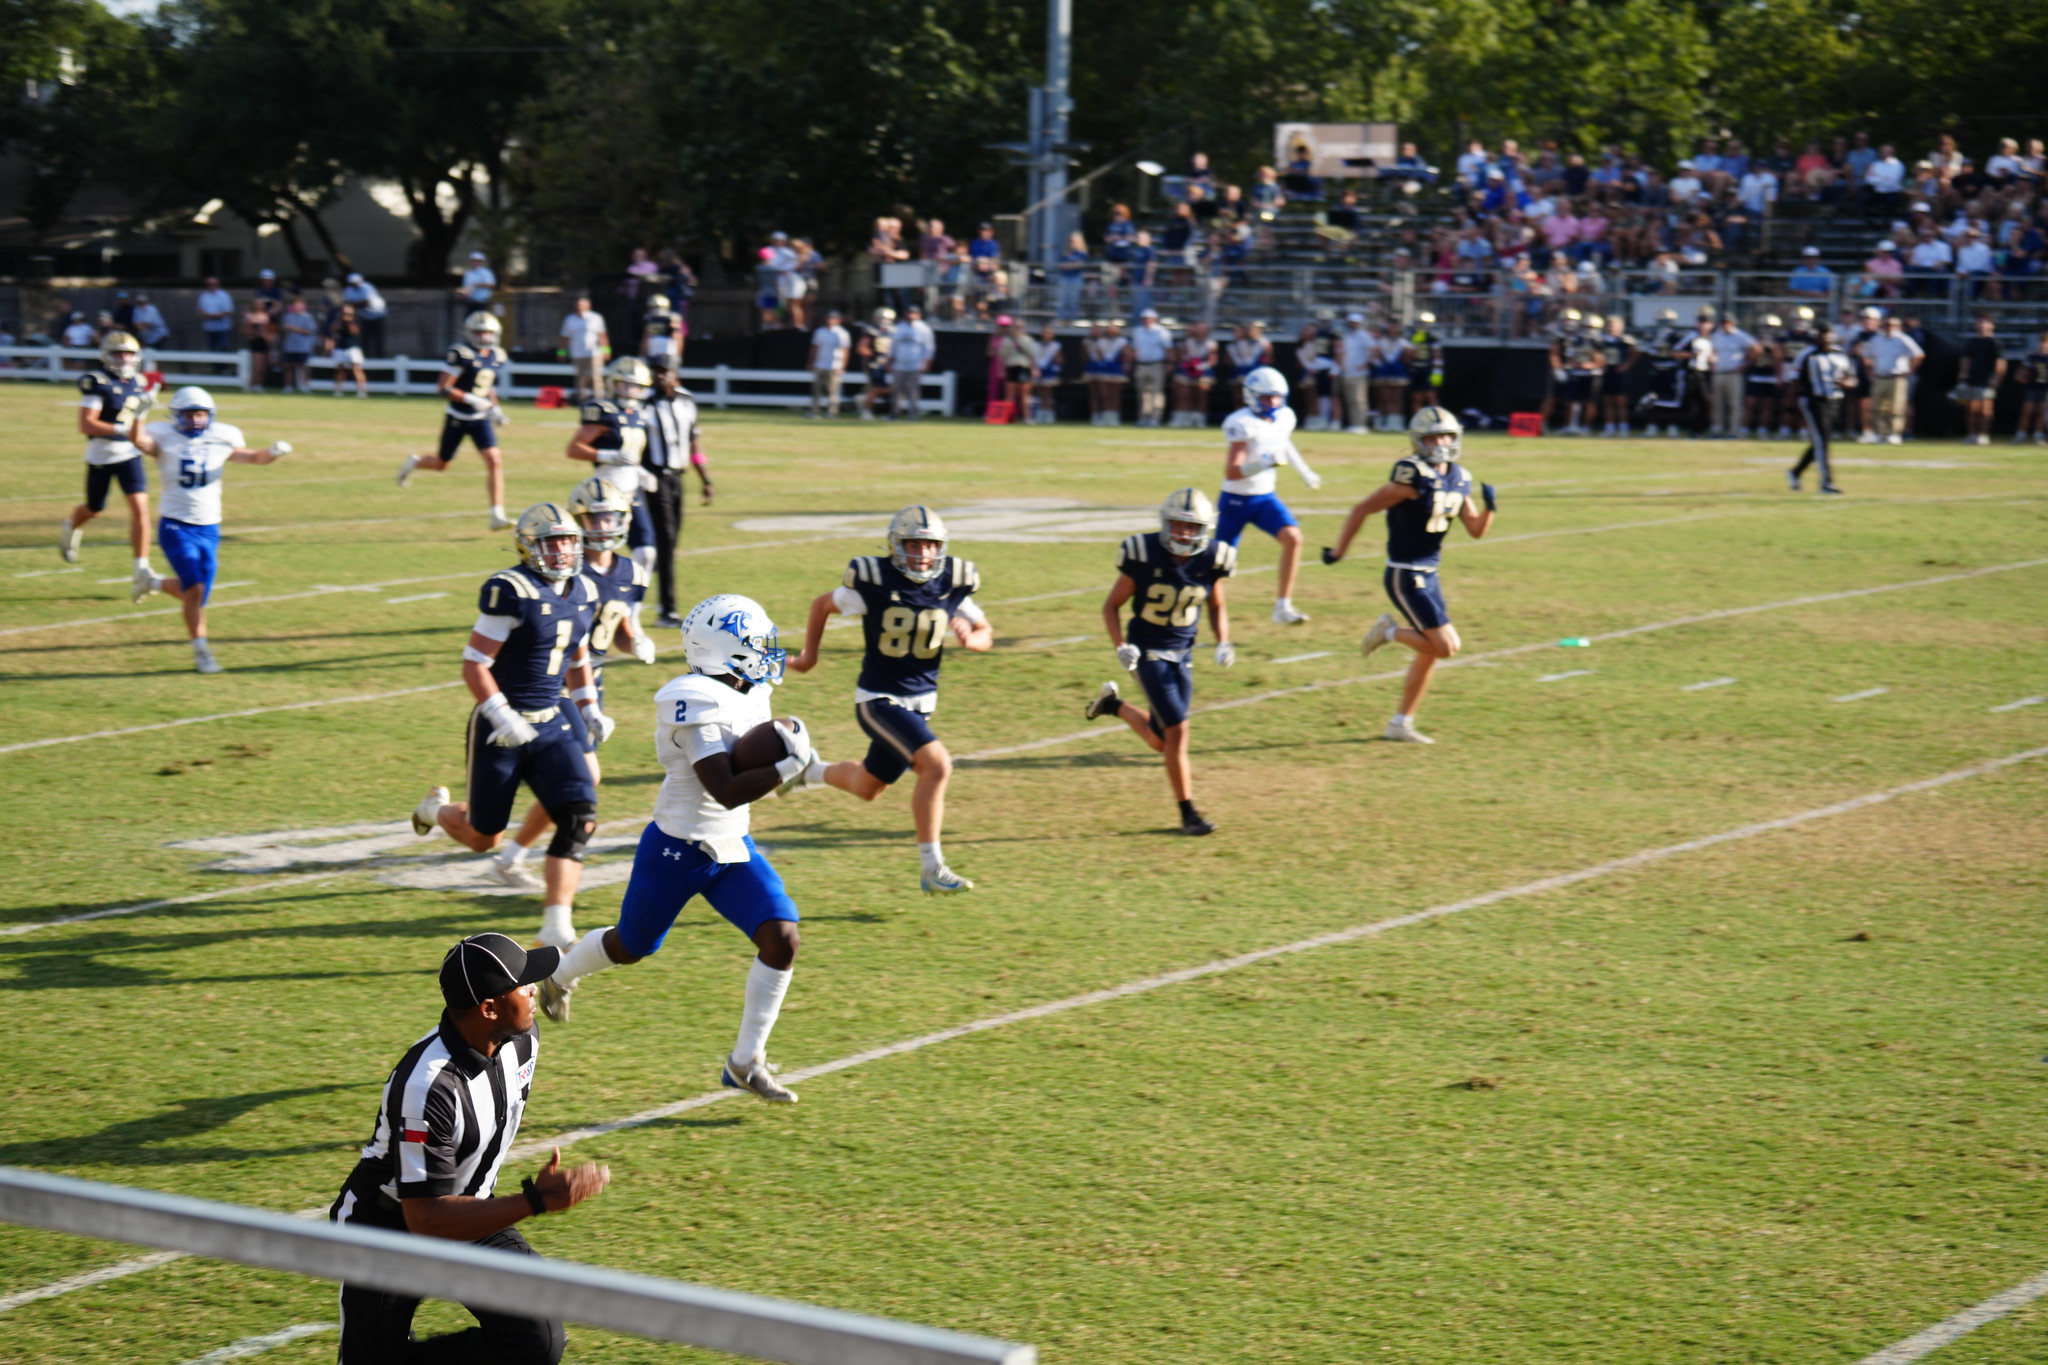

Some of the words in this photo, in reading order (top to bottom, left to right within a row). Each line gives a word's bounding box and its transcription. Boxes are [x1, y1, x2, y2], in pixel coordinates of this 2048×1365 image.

[179, 459, 209, 488] 51
[1394, 466, 1415, 484] 12
[488, 586, 500, 608] 1
[1141, 584, 1207, 627] 20
[878, 606, 949, 659] 80
[547, 620, 573, 676] 1
[675, 701, 687, 722] 2
